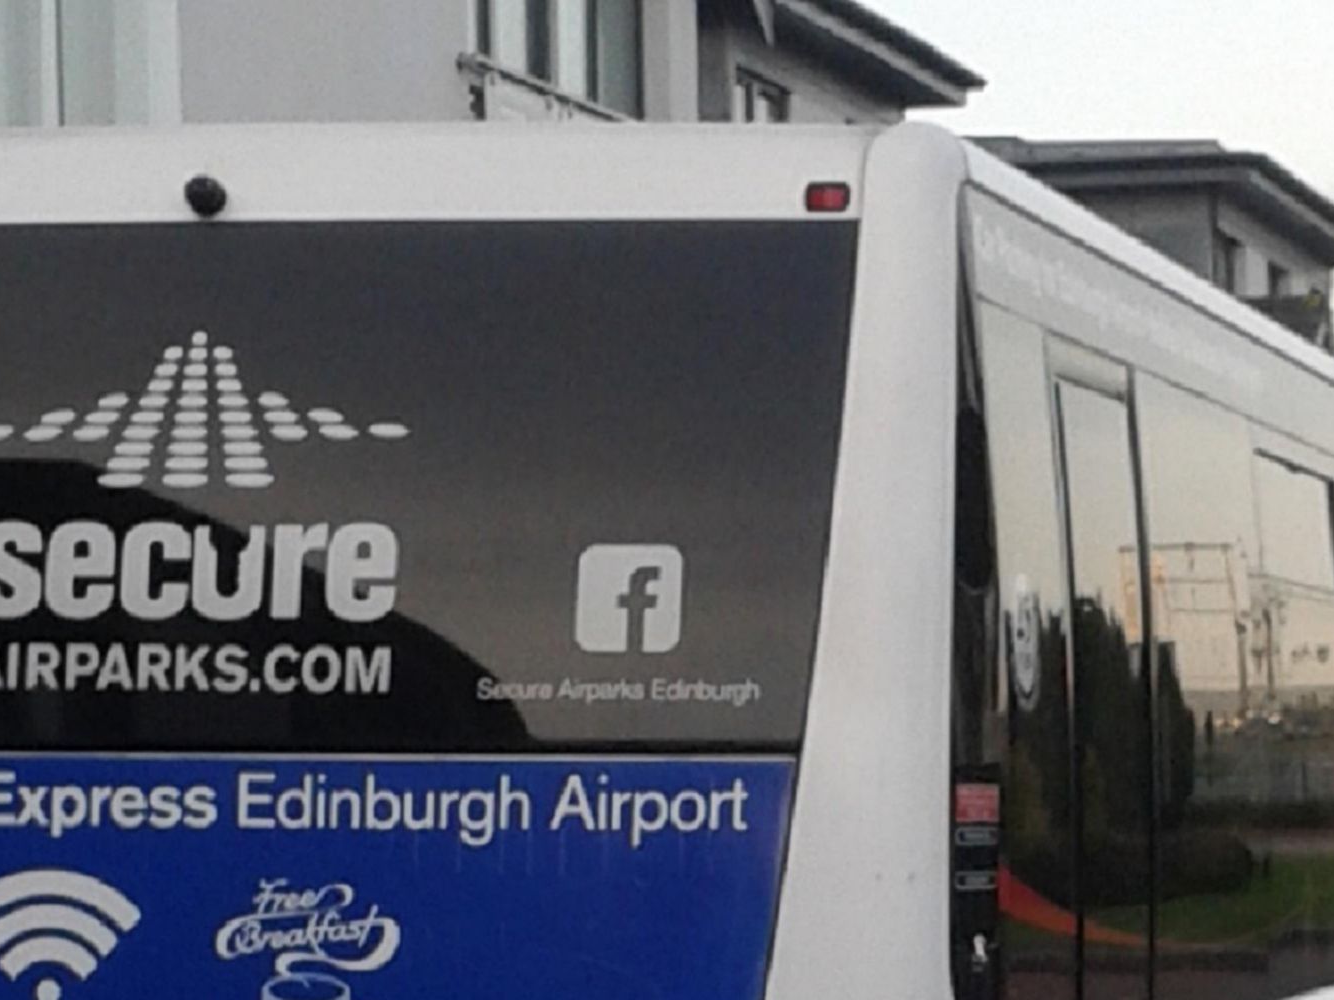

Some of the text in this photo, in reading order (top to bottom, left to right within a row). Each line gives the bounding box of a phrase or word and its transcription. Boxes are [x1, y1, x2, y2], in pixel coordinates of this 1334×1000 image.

[476, 676, 761, 707] Secure Airparks Edinburgh
[237, 773, 530, 846] Edinburgh
[549, 774, 749, 849] Airport
[252, 877, 337, 914] Free
[227, 904, 387, 957] Breakfast
